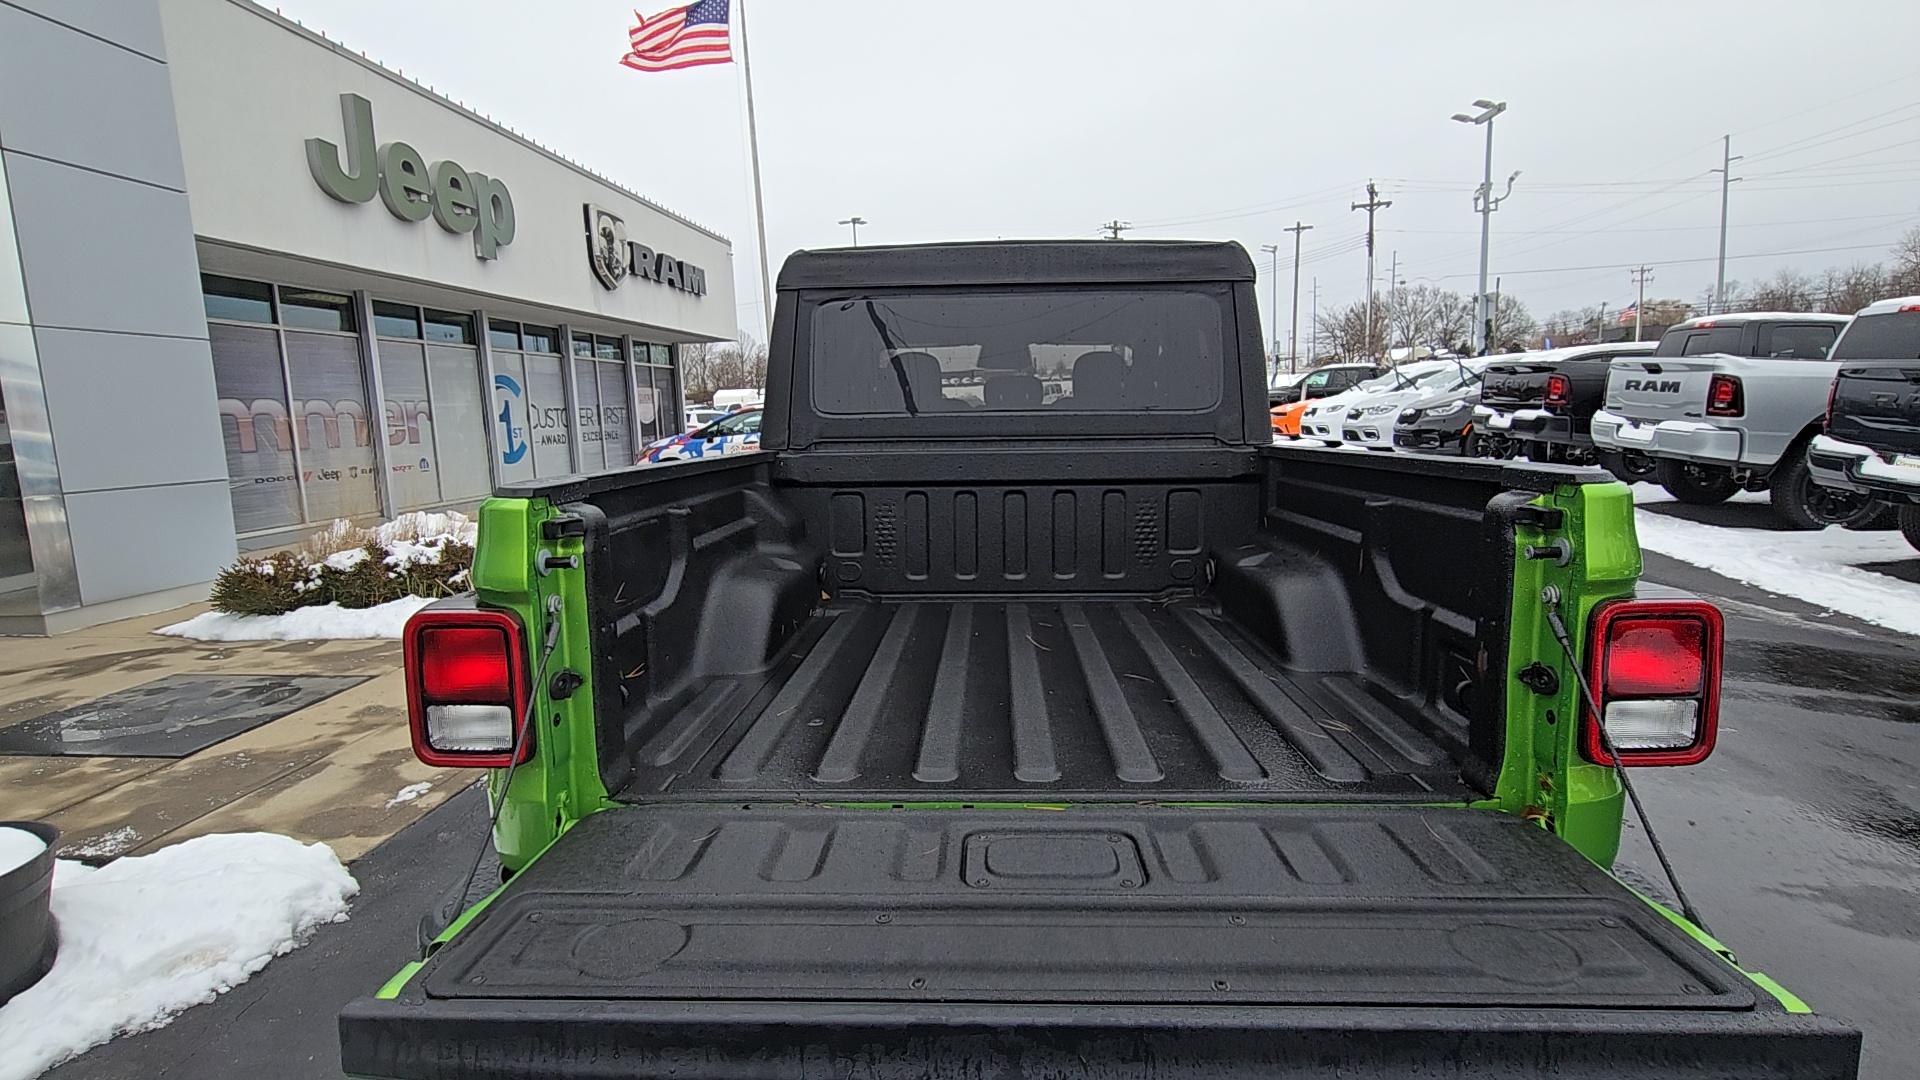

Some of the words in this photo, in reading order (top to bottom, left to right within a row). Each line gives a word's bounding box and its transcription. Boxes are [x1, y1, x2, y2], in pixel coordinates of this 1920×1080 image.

[305, 93, 515, 261] Jeep
[627, 241, 707, 296] RAM
[1624, 379, 1681, 393] RAM
[529, 403, 595, 429] CUSTOER
[541, 433, 567, 446] AWARD
[582, 429, 619, 442] EXCELENCE
[254, 476, 295, 484] DODG
[317, 468, 342, 481] Jeep
